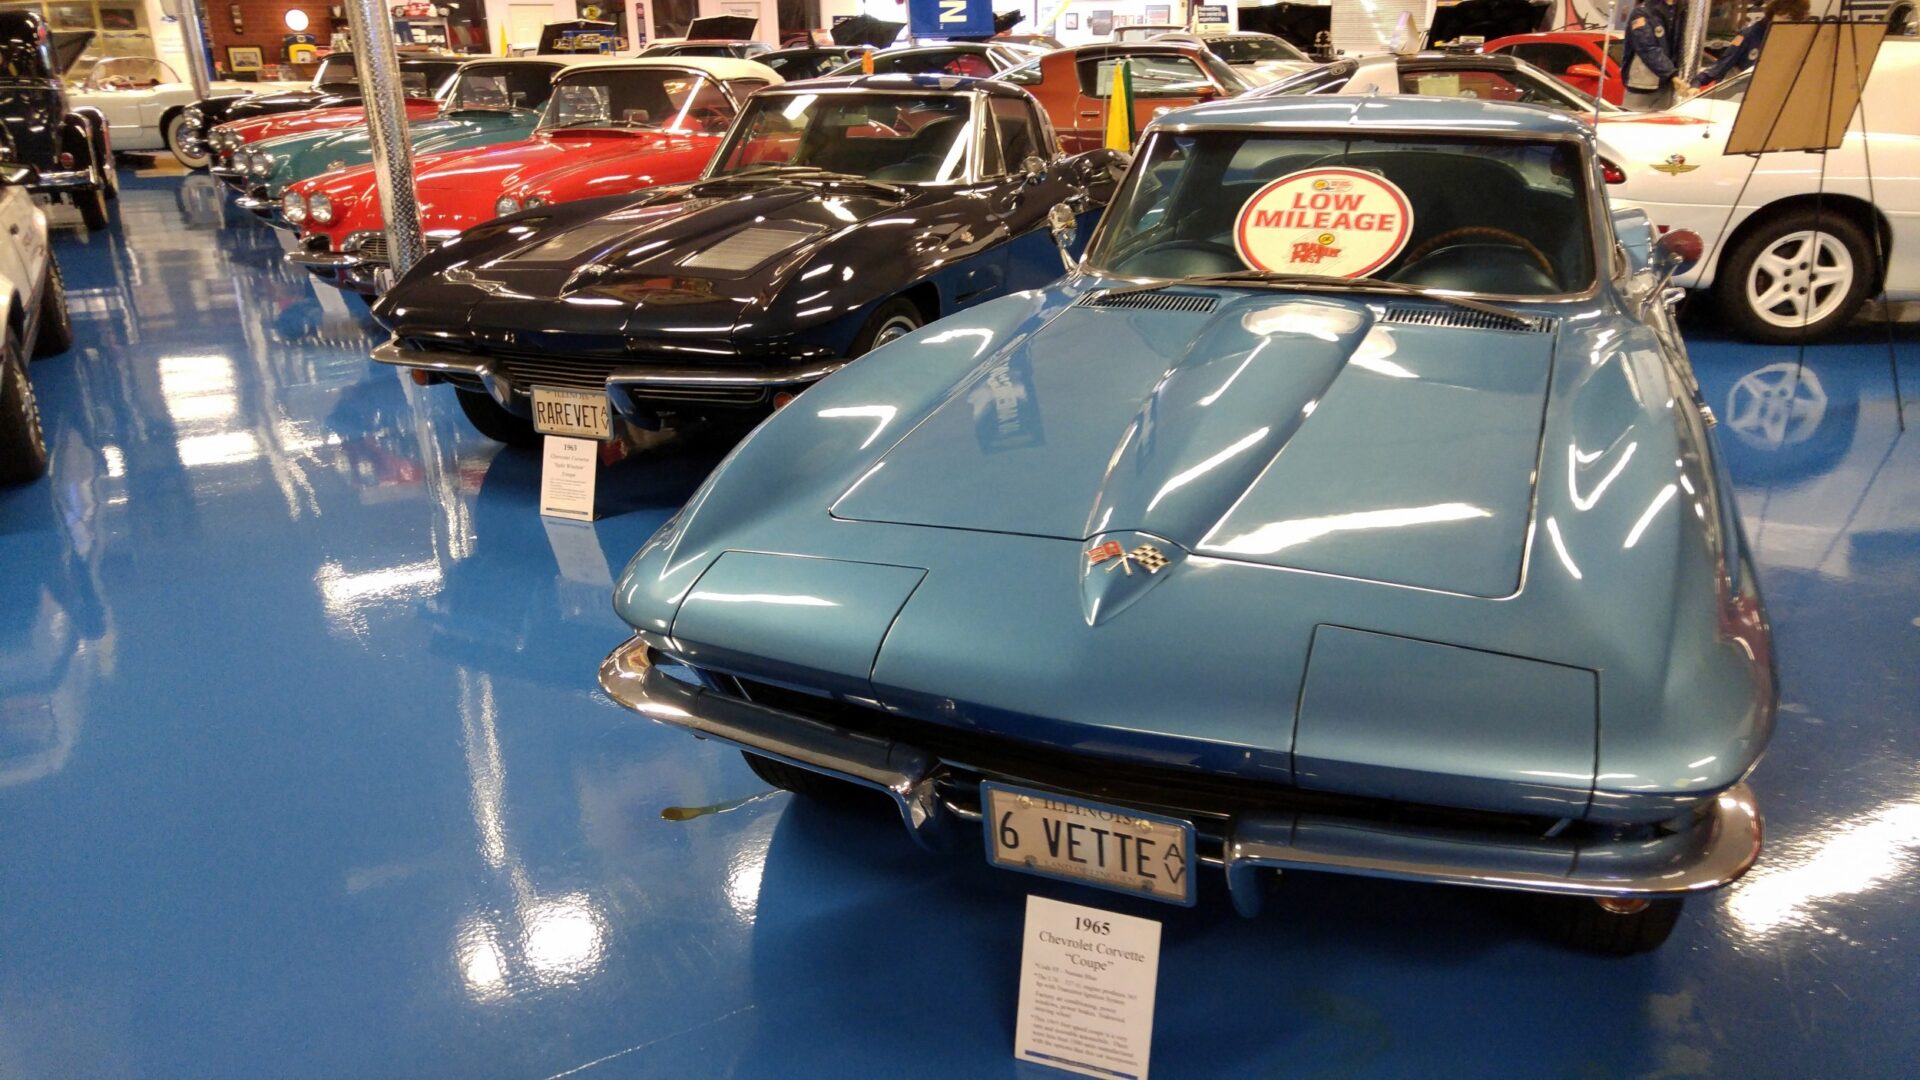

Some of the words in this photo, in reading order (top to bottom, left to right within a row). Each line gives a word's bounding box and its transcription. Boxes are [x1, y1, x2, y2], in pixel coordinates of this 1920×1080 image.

[1292, 192, 1366, 211] LOW
[1253, 209, 1396, 232] MILEAGE
[537, 401, 598, 429] RAREVET
[1000, 811, 1020, 849] 6
[1042, 817, 1157, 879] VETTE
[1075, 916, 1111, 936] 1965
[1039, 930, 1093, 952] Chevrolet
[1096, 943, 1145, 963] Corvette
